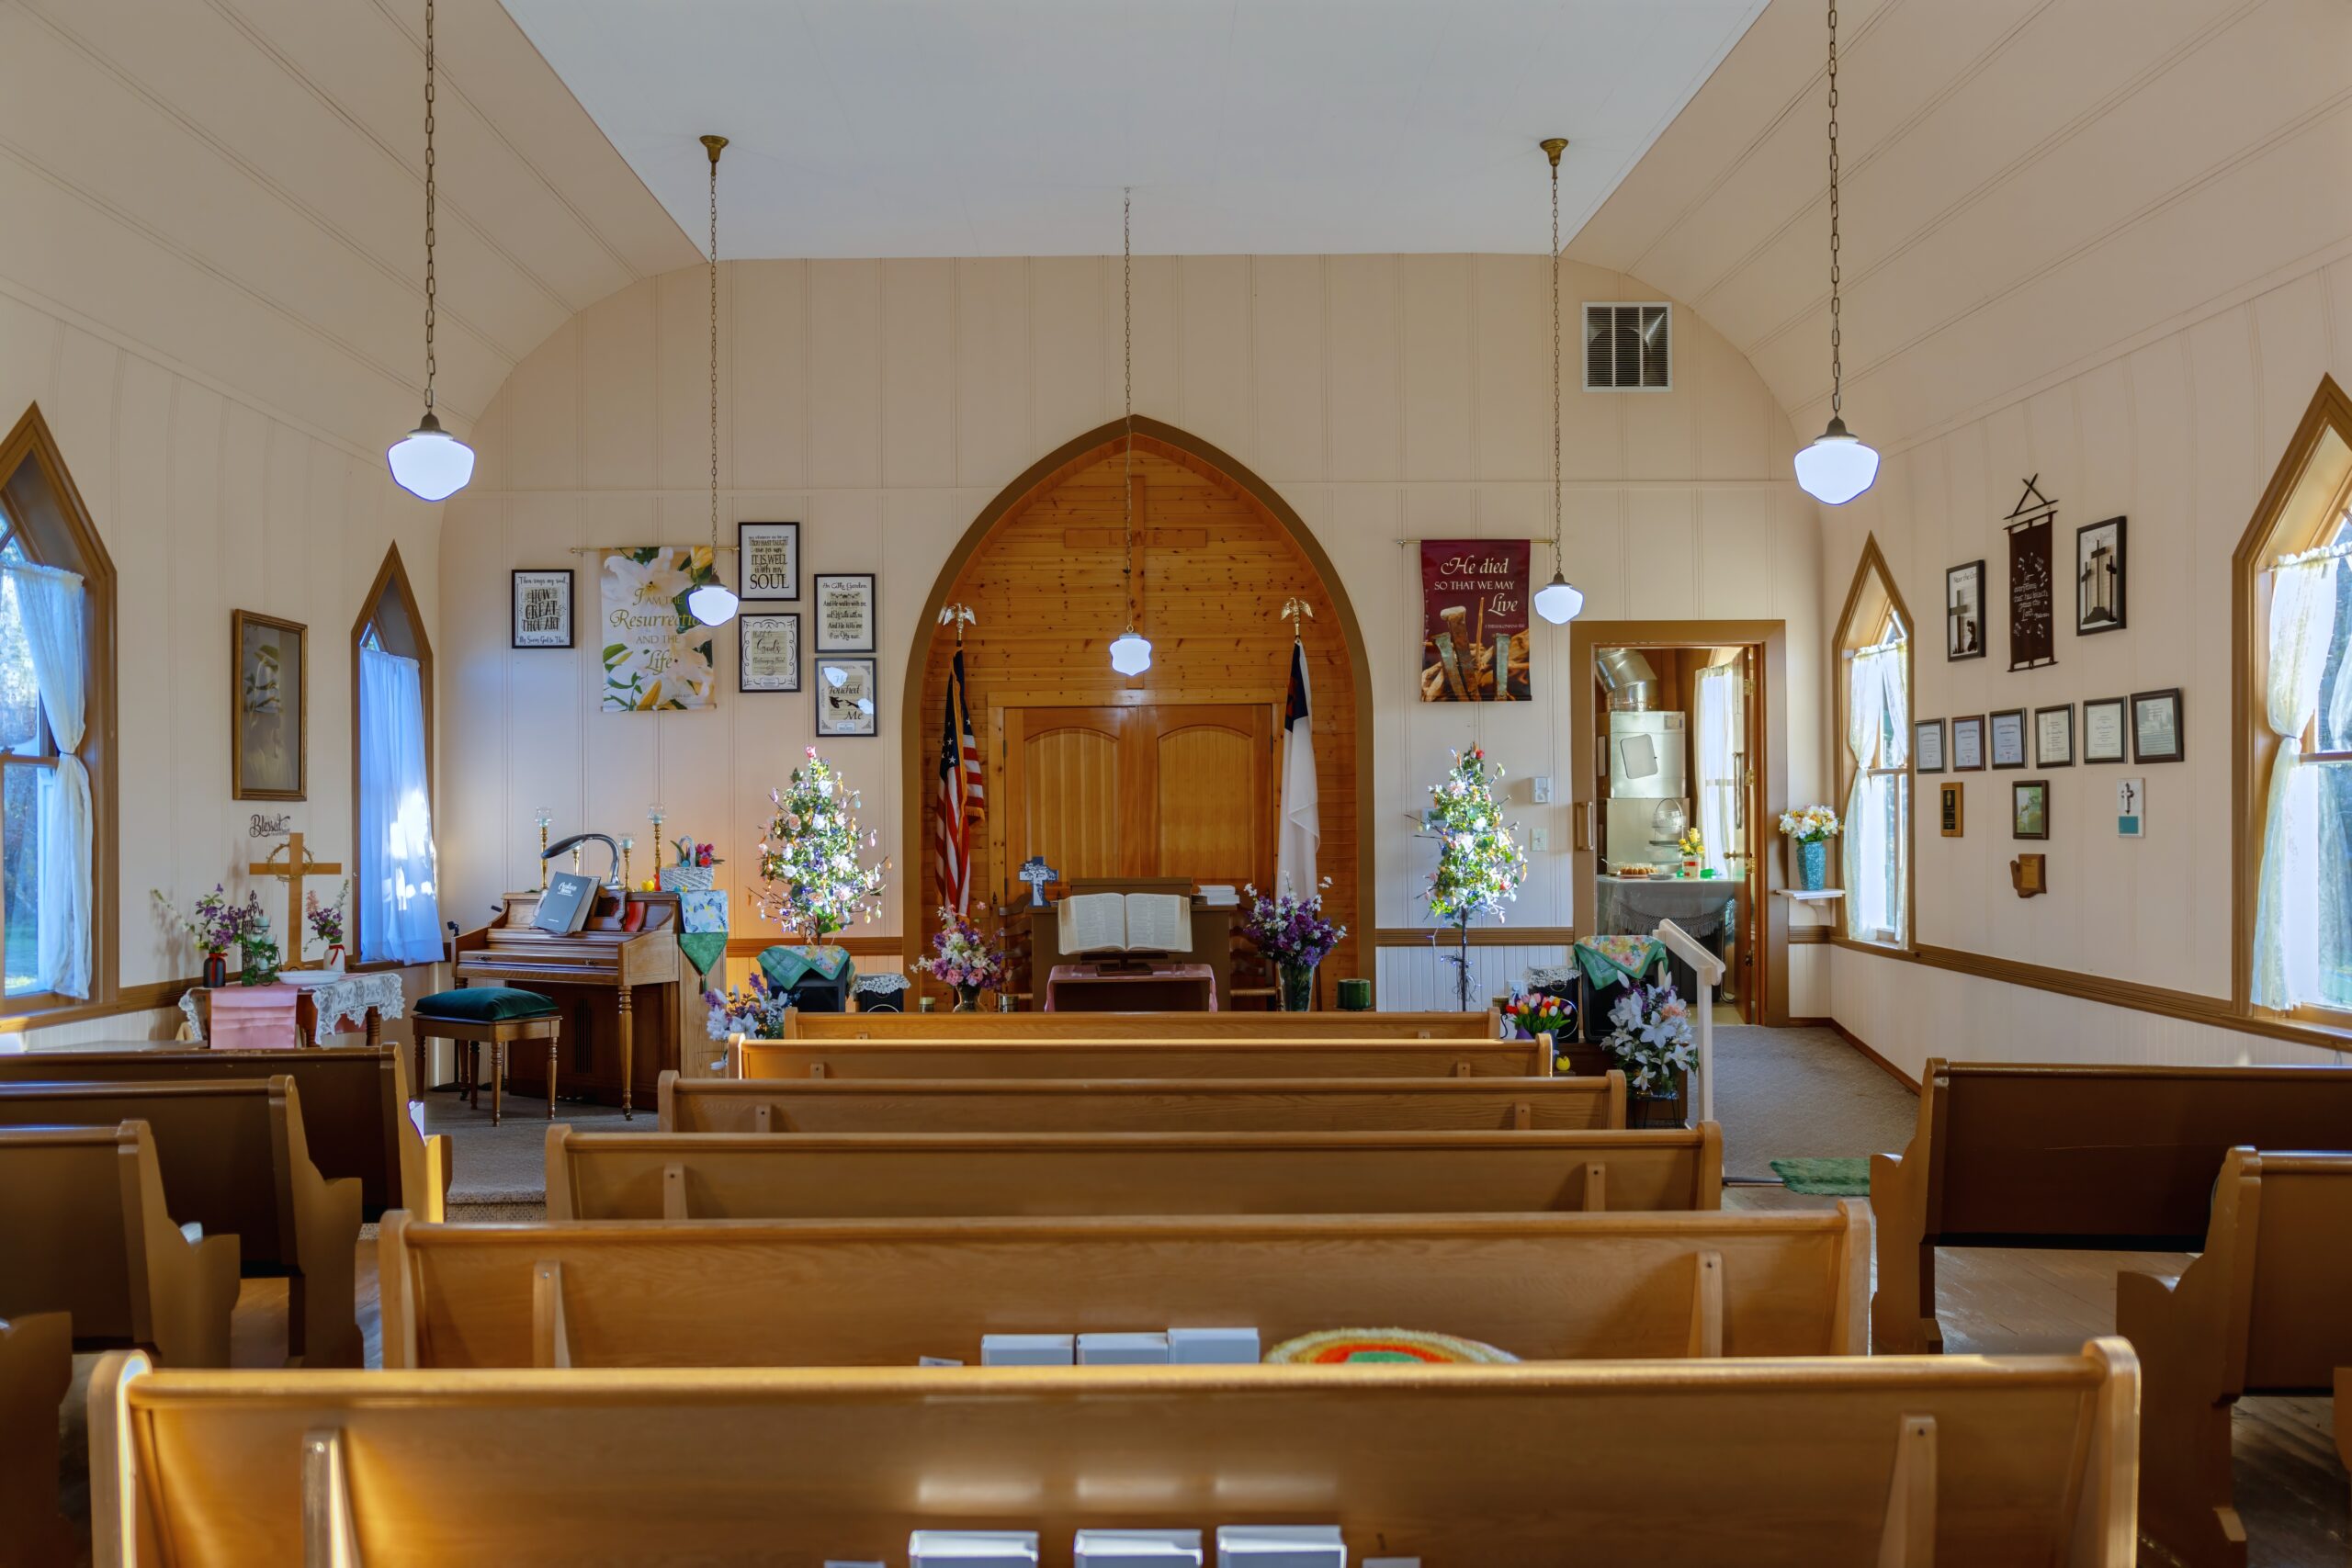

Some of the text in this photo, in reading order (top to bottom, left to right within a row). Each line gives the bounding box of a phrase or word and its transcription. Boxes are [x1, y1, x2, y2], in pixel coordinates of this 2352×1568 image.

[768, 554, 788, 565] WELL
[1441, 555, 1510, 575] He died
[750, 573, 790, 590] SOUL
[1434, 581, 1515, 591] SO THAT WE MAY
[530, 589, 552, 604] HOW
[646, 596, 662, 605] AM
[664, 596, 684, 605] THE
[1487, 592, 1519, 617] Live
[525, 600, 559, 620] GREAT
[522, 616, 560, 632] THOU ART
[609, 609, 703, 630] Resurrectio
[636, 635, 681, 645] AND THE
[645, 649, 673, 676] Life
[829, 683, 862, 694] Touched
[844, 711, 864, 720] Me
[249, 813, 291, 838] Blessed
